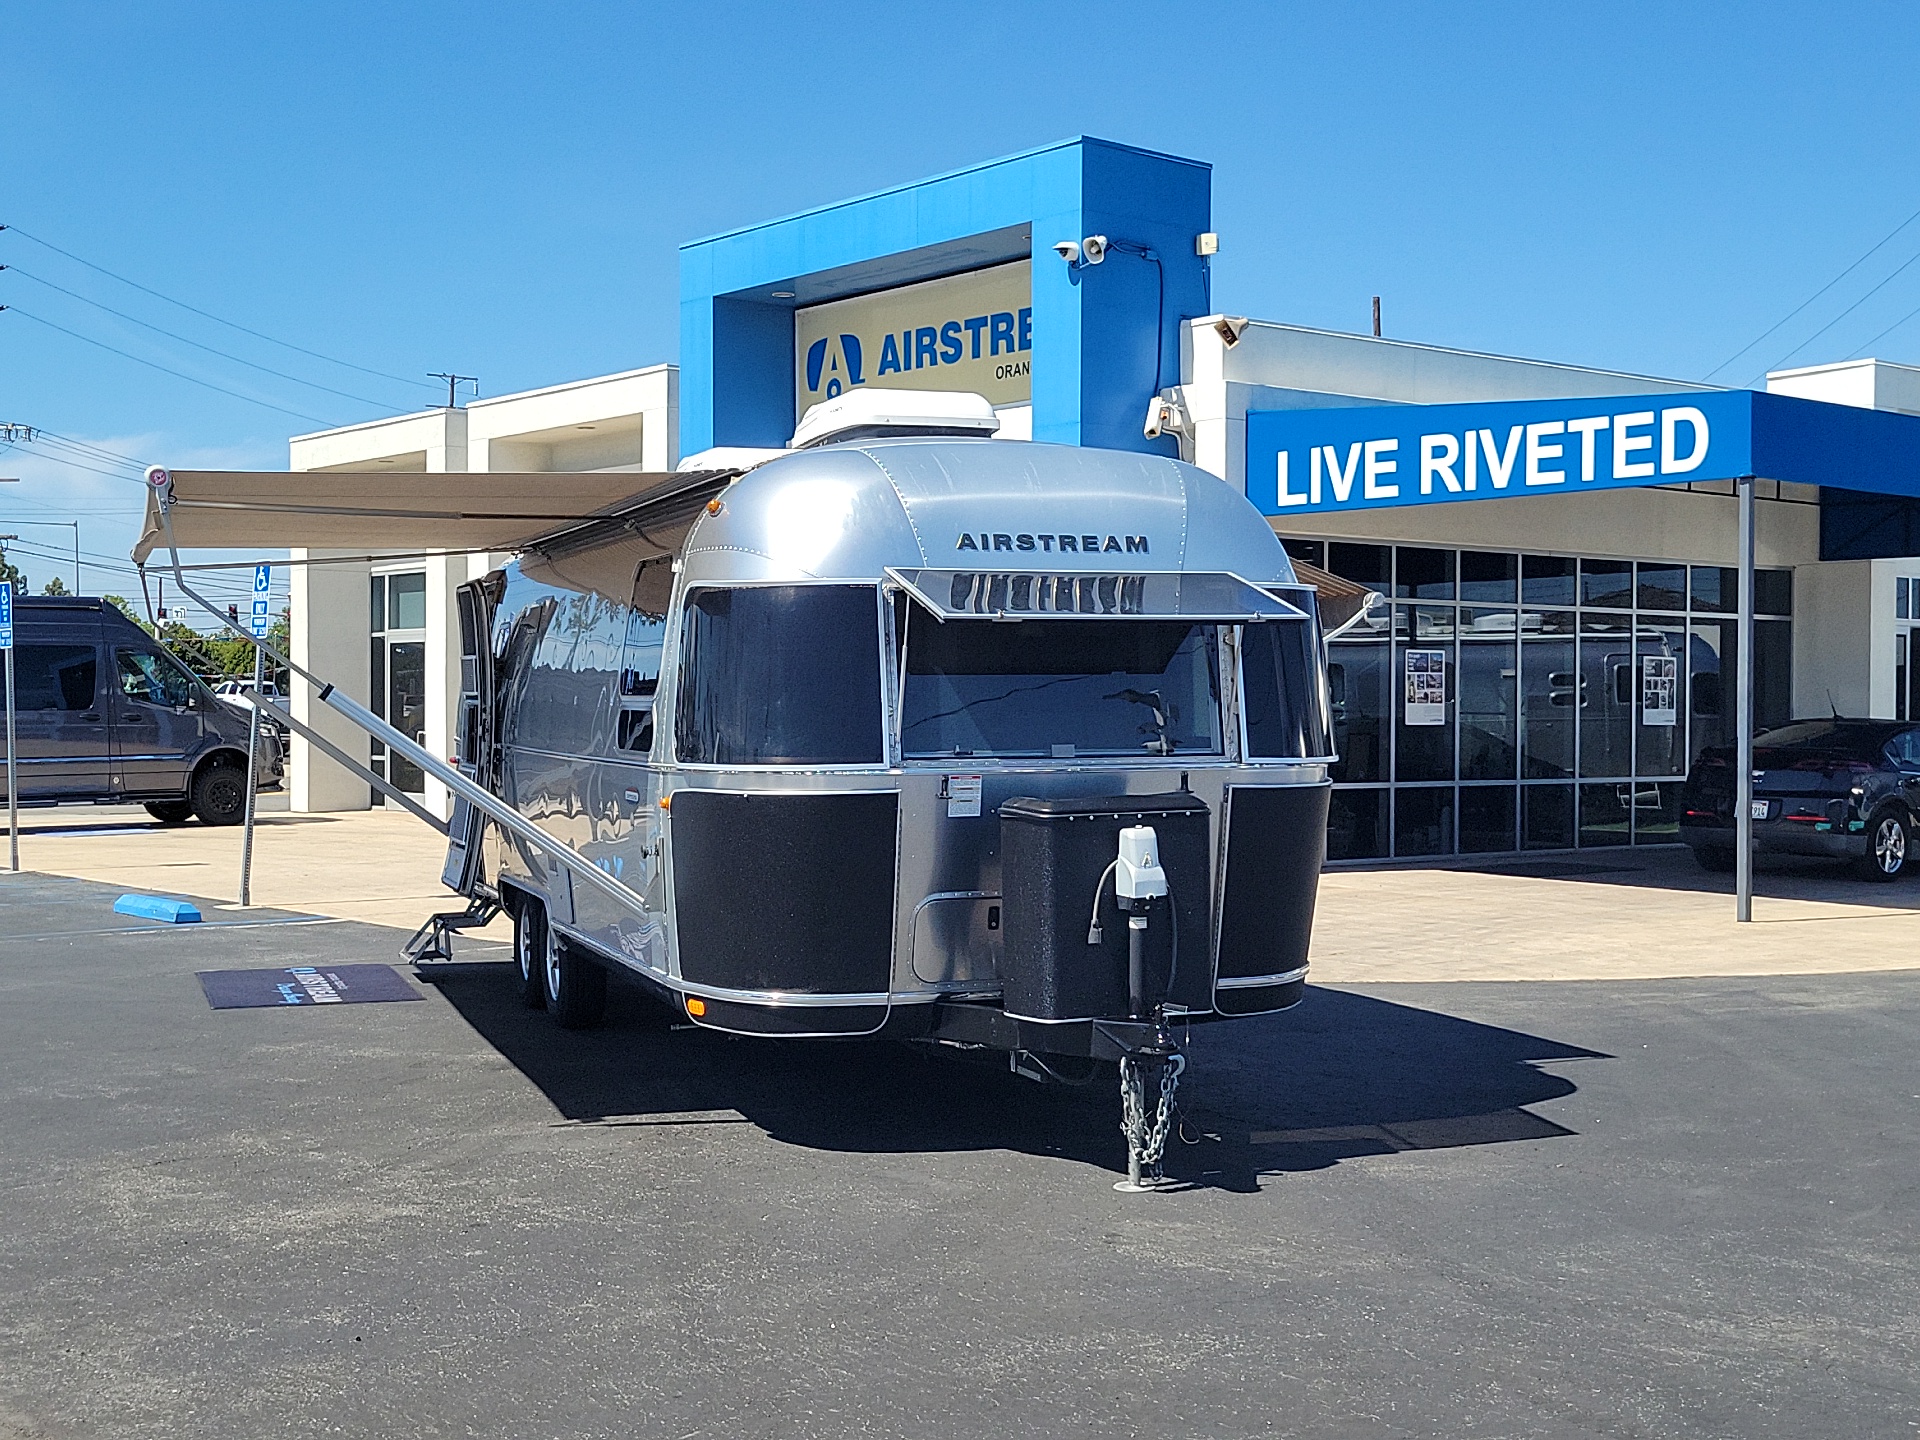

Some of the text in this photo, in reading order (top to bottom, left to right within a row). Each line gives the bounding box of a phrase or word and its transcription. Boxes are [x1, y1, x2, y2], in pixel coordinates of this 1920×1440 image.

[877, 306, 1032, 376] AIRSTRE
[995, 360, 1032, 380] ORAN
[1276, 405, 1710, 507] LIVE RIVETED
[955, 532, 1150, 555] AIRSTREAM
